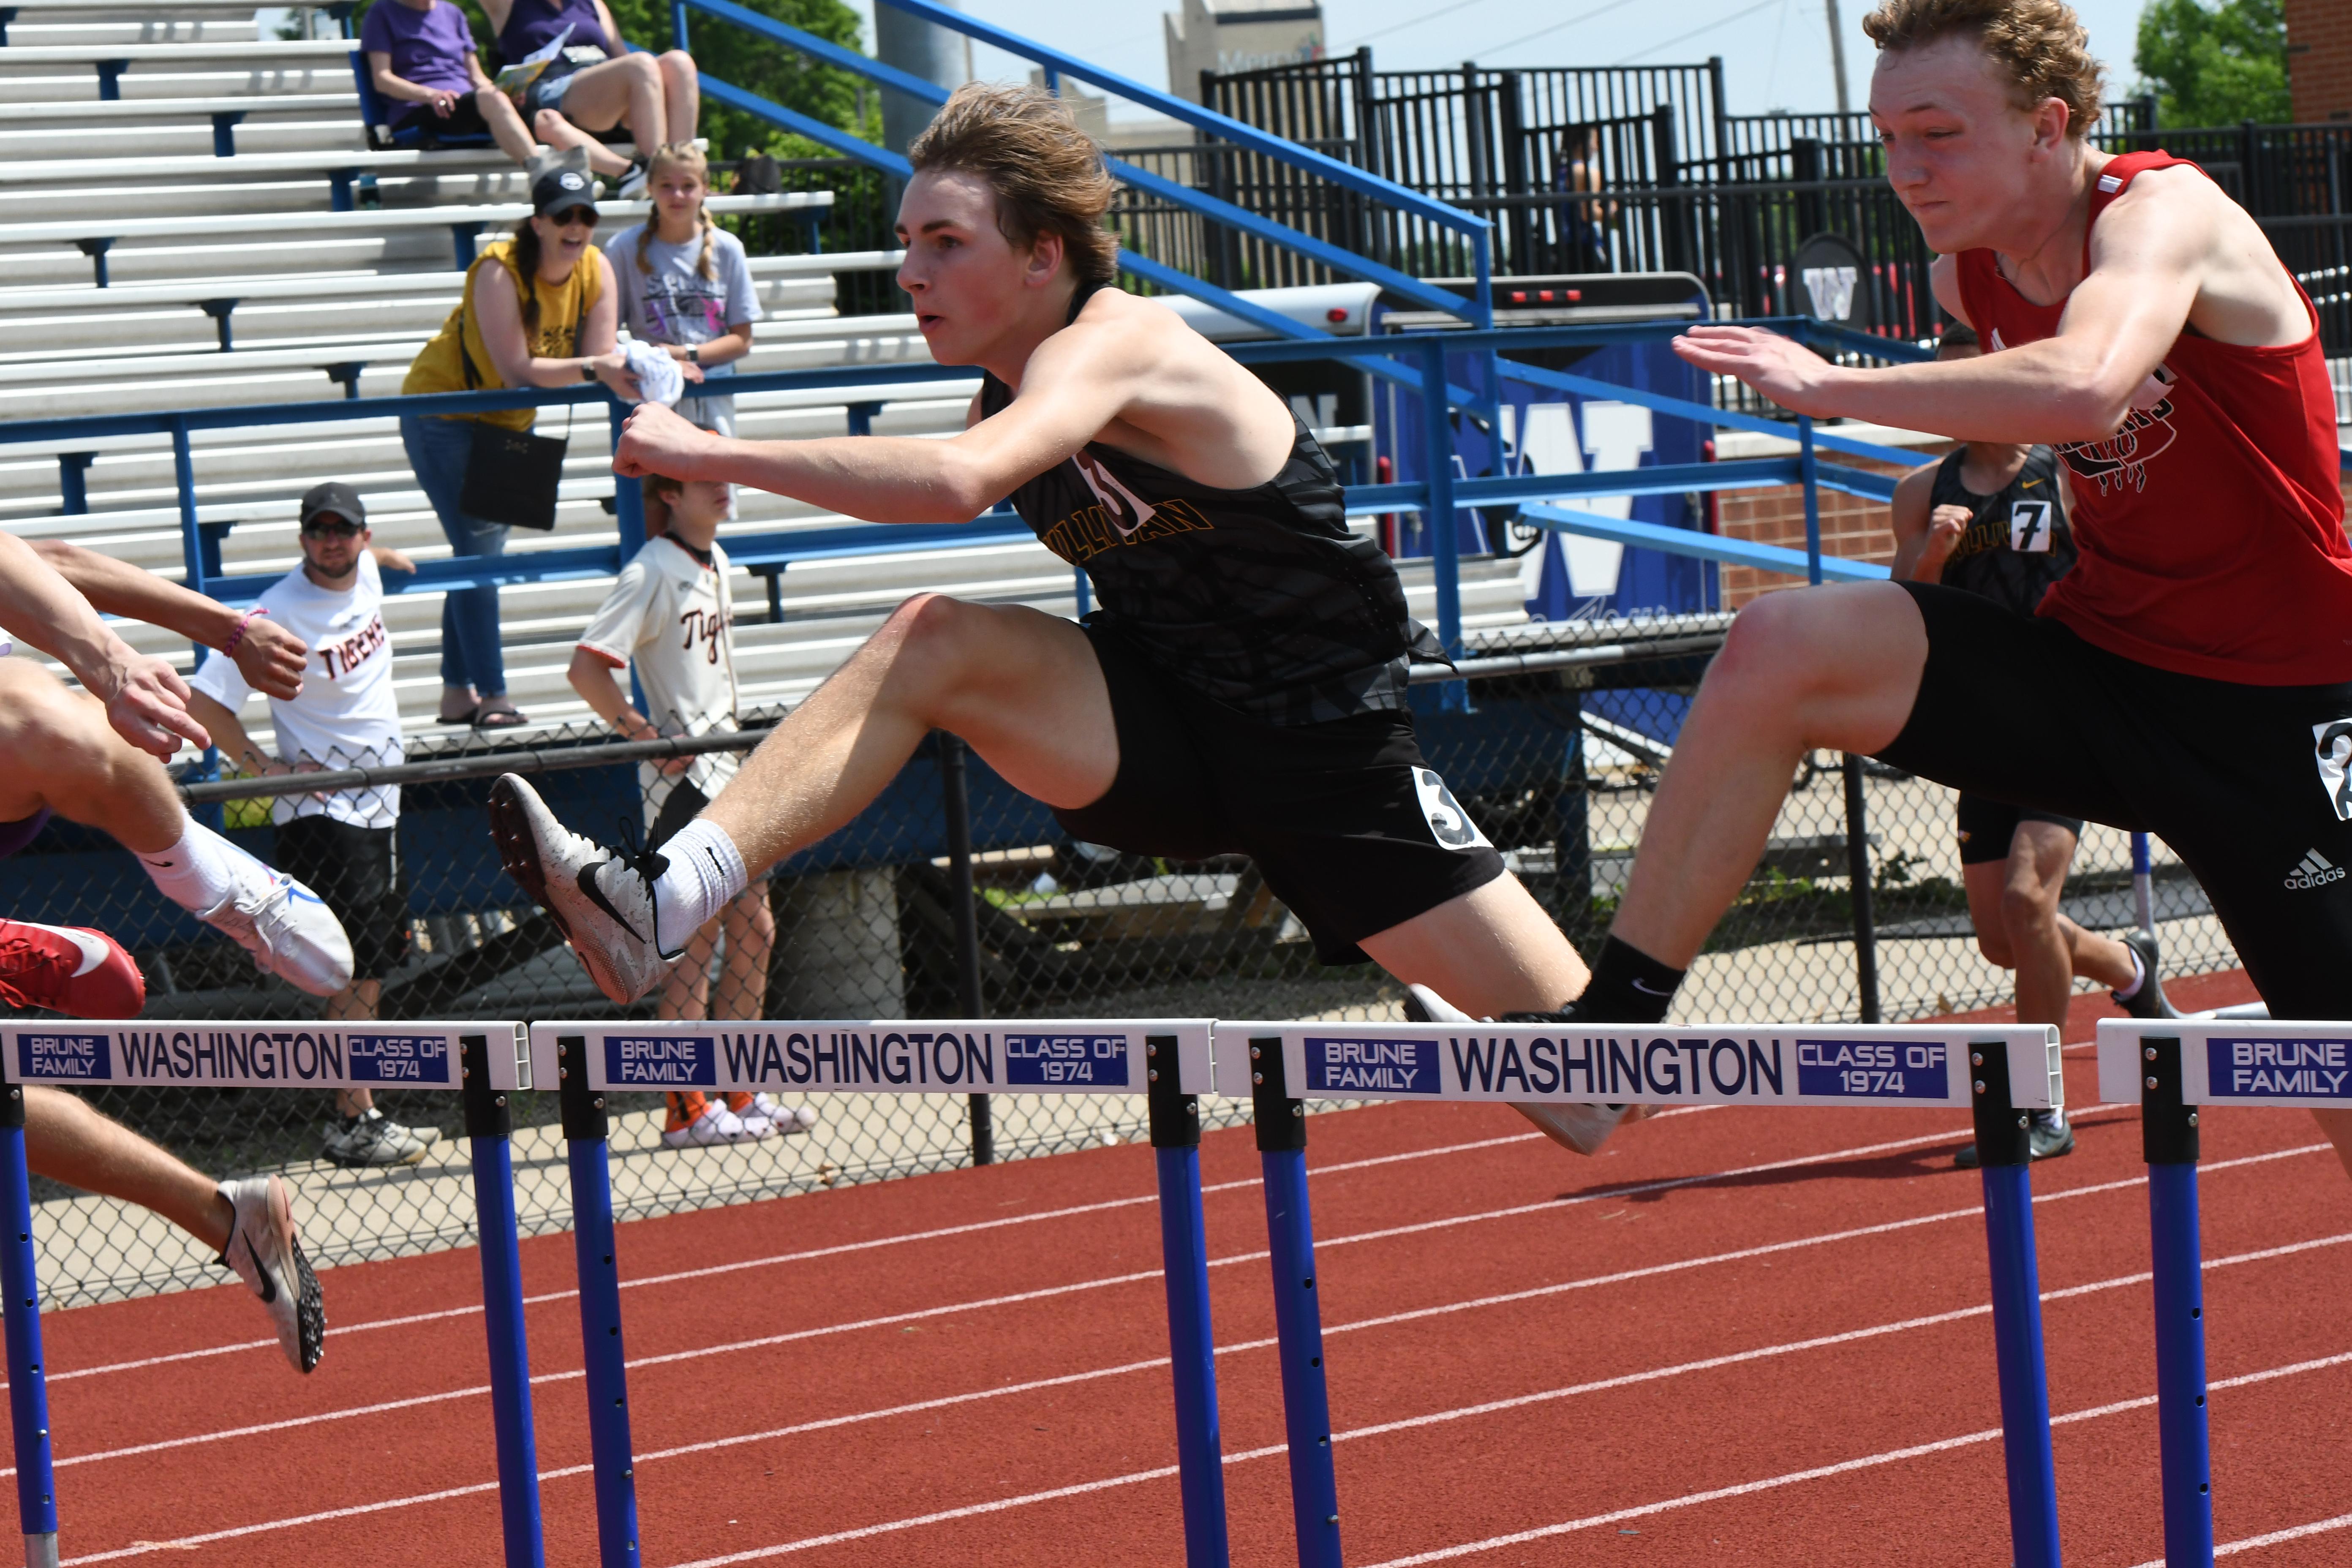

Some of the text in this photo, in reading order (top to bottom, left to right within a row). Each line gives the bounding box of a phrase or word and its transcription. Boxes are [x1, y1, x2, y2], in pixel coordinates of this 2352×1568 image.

[2014, 505, 2045, 550] 7
[2284, 867, 2346, 890] adidas
[32, 1038, 94, 1055] BRUNE
[118, 1032, 343, 1080] WASHINGTON
[349, 1038, 446, 1058] CLASS OF
[621, 1041, 696, 1060] BRUNE
[1005, 1038, 1126, 1059] CLASS OF
[1325, 1043, 1417, 1065] BRUNE
[1799, 1045, 1945, 1069] CLASS OF
[2232, 1043, 2346, 1067] BRUNE
[33, 1057, 95, 1075] FAMILY
[376, 1060, 420, 1078] 1974
[721, 1033, 994, 1084] WASHINGTON
[1450, 1038, 1783, 1096] WASHINGTON
[622, 1062, 698, 1081] FAMILY
[1040, 1062, 1093, 1081] 1974
[1326, 1066, 1419, 1089] FAMILY
[1839, 1070, 1905, 1094] 1974
[2233, 1069, 2349, 1093] FAMILY
